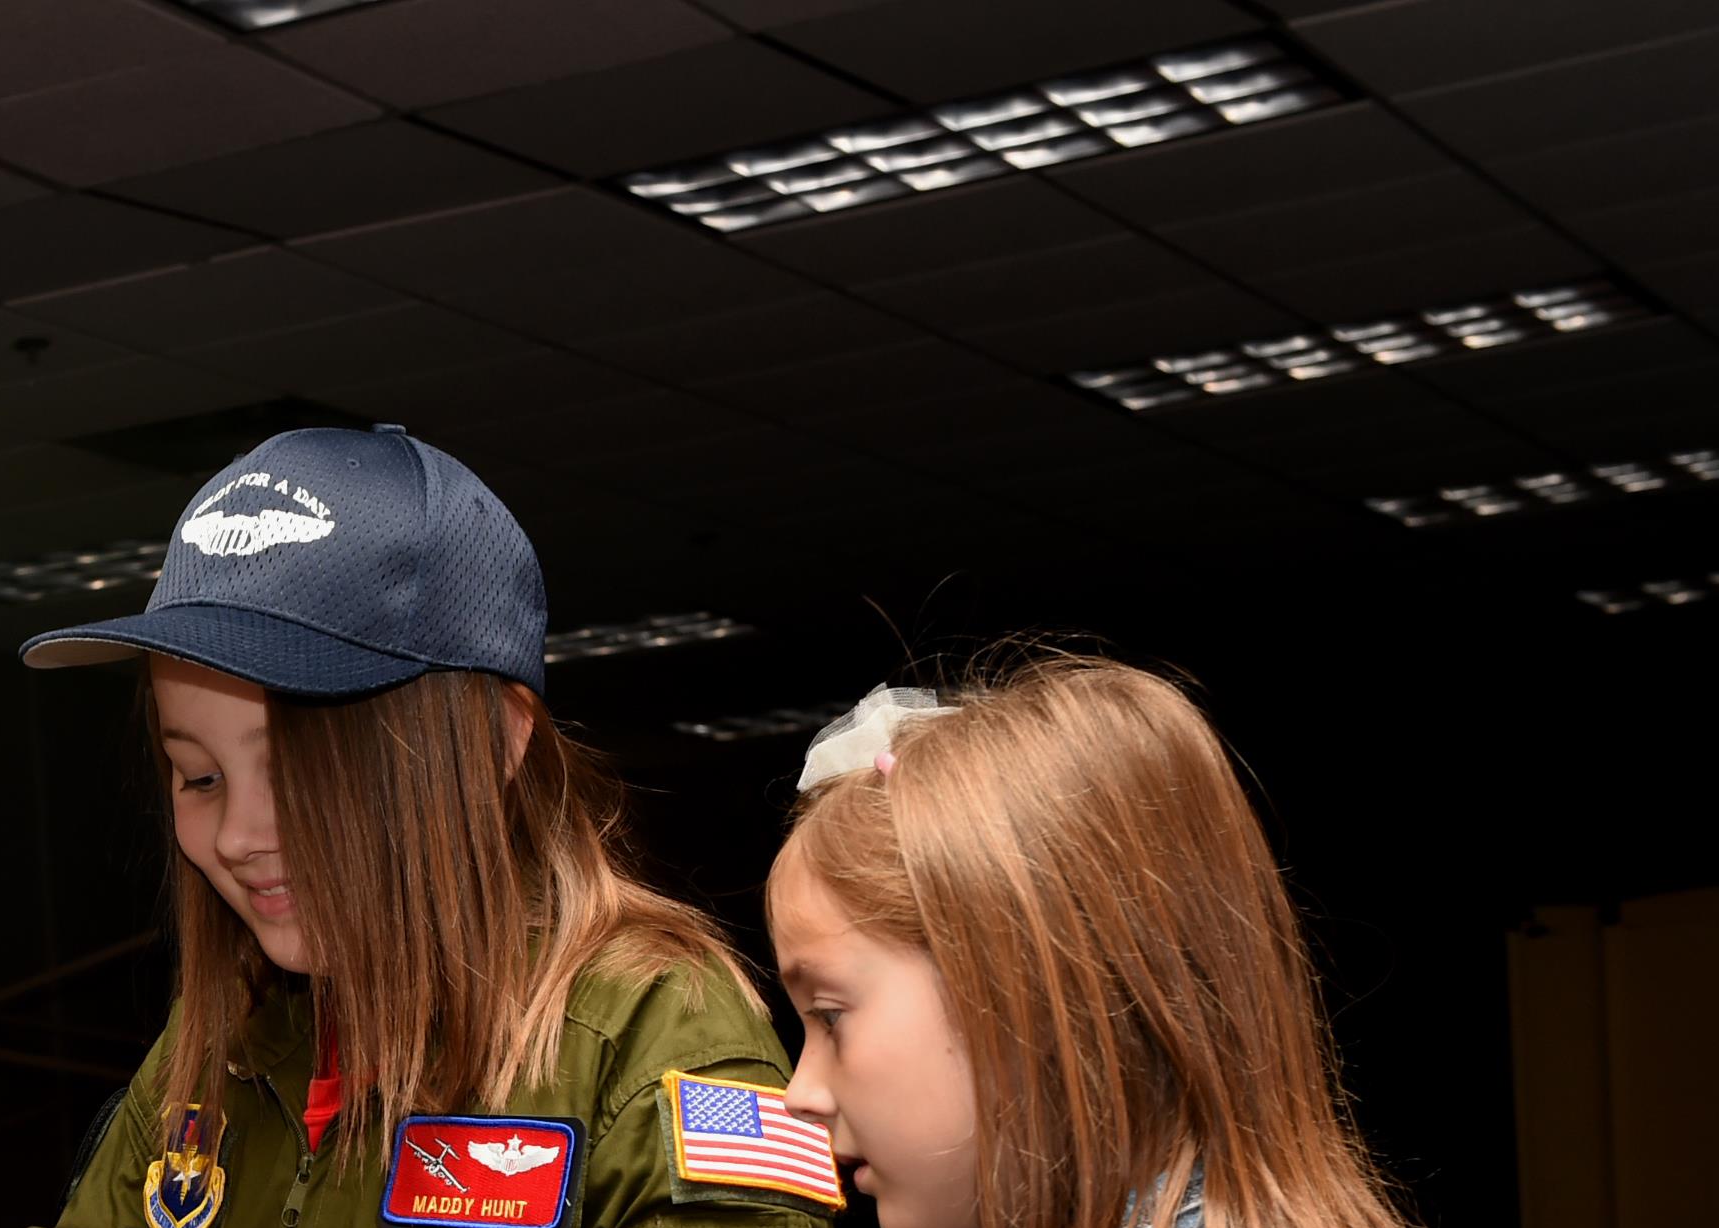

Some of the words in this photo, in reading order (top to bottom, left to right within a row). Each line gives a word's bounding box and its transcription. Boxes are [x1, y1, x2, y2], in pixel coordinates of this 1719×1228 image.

[235, 472, 271, 489] FOR
[274, 479, 288, 495] A
[292, 486, 331, 520] DAY
[412, 1195, 475, 1216] MADDY
[481, 1199, 528, 1219] HUNT
